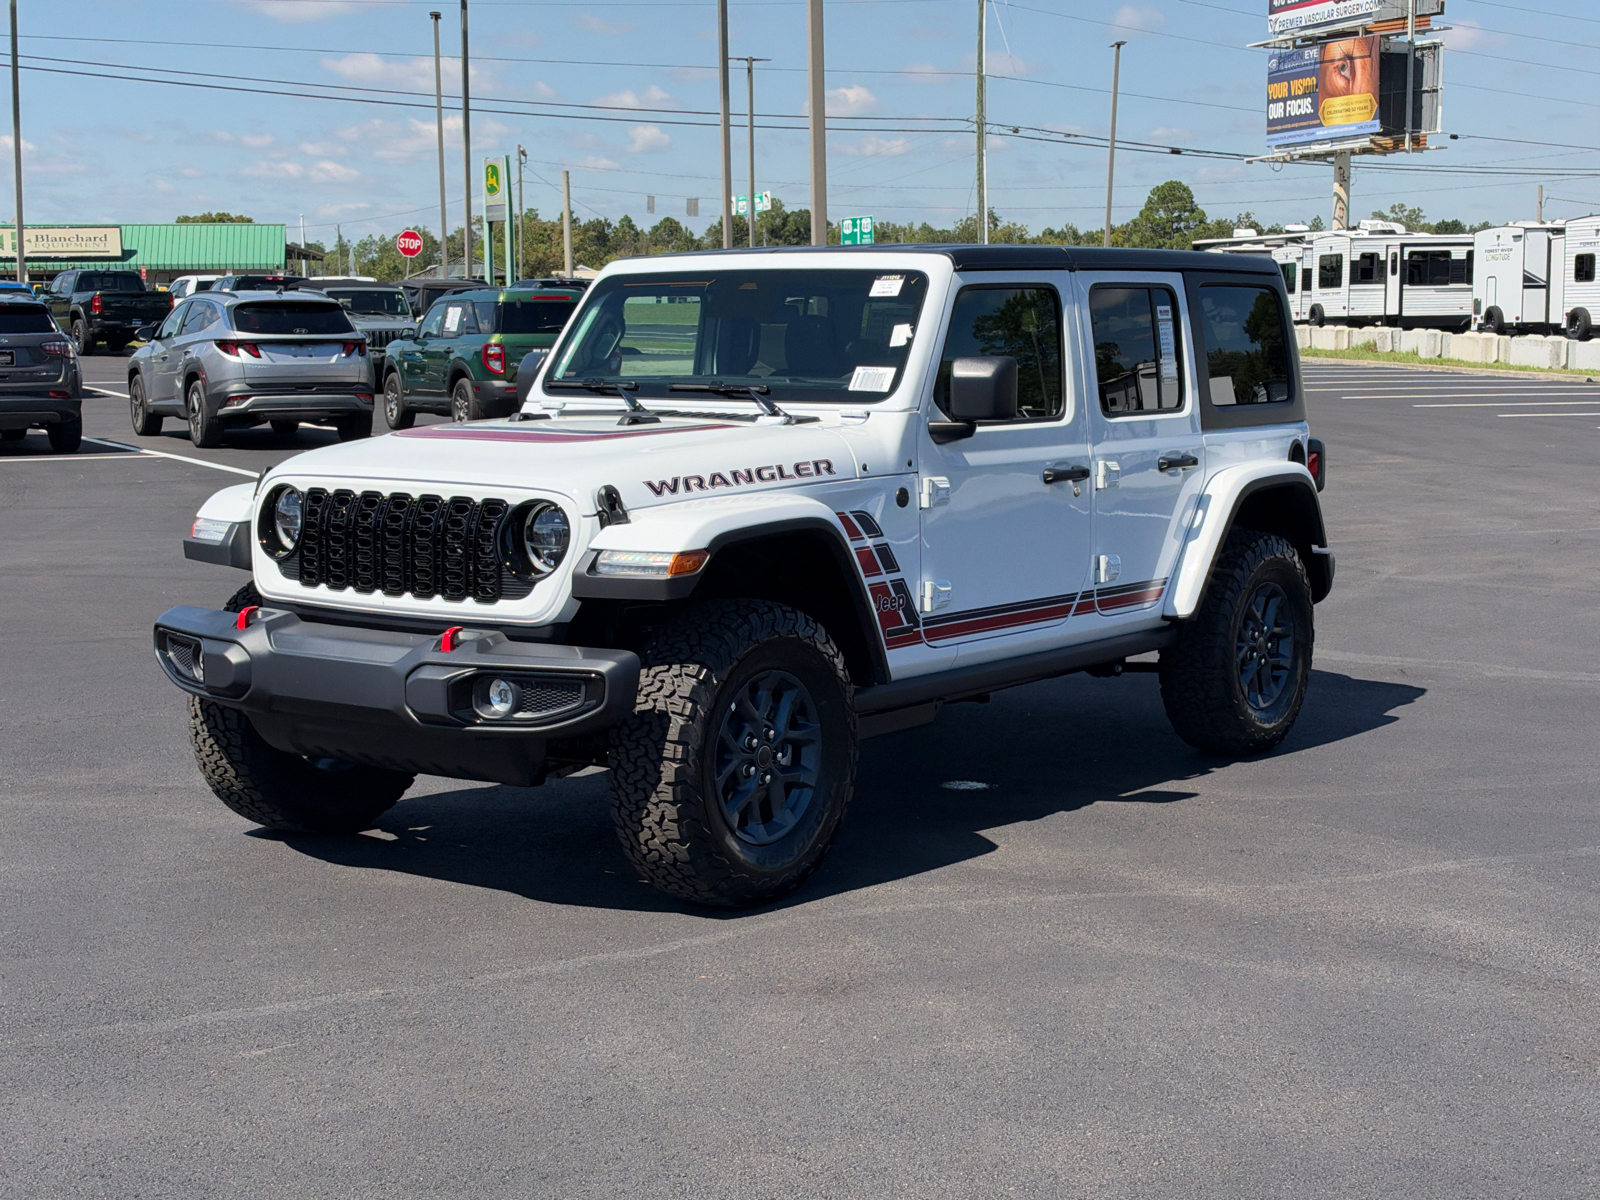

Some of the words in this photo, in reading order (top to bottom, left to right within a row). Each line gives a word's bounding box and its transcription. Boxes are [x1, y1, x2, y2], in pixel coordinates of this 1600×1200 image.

[1279, 16, 1302, 29] PREMIER
[1304, 8, 1334, 24] VASCULAR
[1305, 48, 1319, 59] EYE
[1268, 81, 1288, 100] YOUR
[1290, 76, 1319, 96] VISION.
[1268, 101, 1284, 119] OUR
[1286, 97, 1314, 117] FOCUS.
[34, 234, 108, 242] Blanchard
[400, 238, 421, 249] STOP
[643, 459, 836, 497] WRANGLER
[875, 593, 906, 613] Jeep
